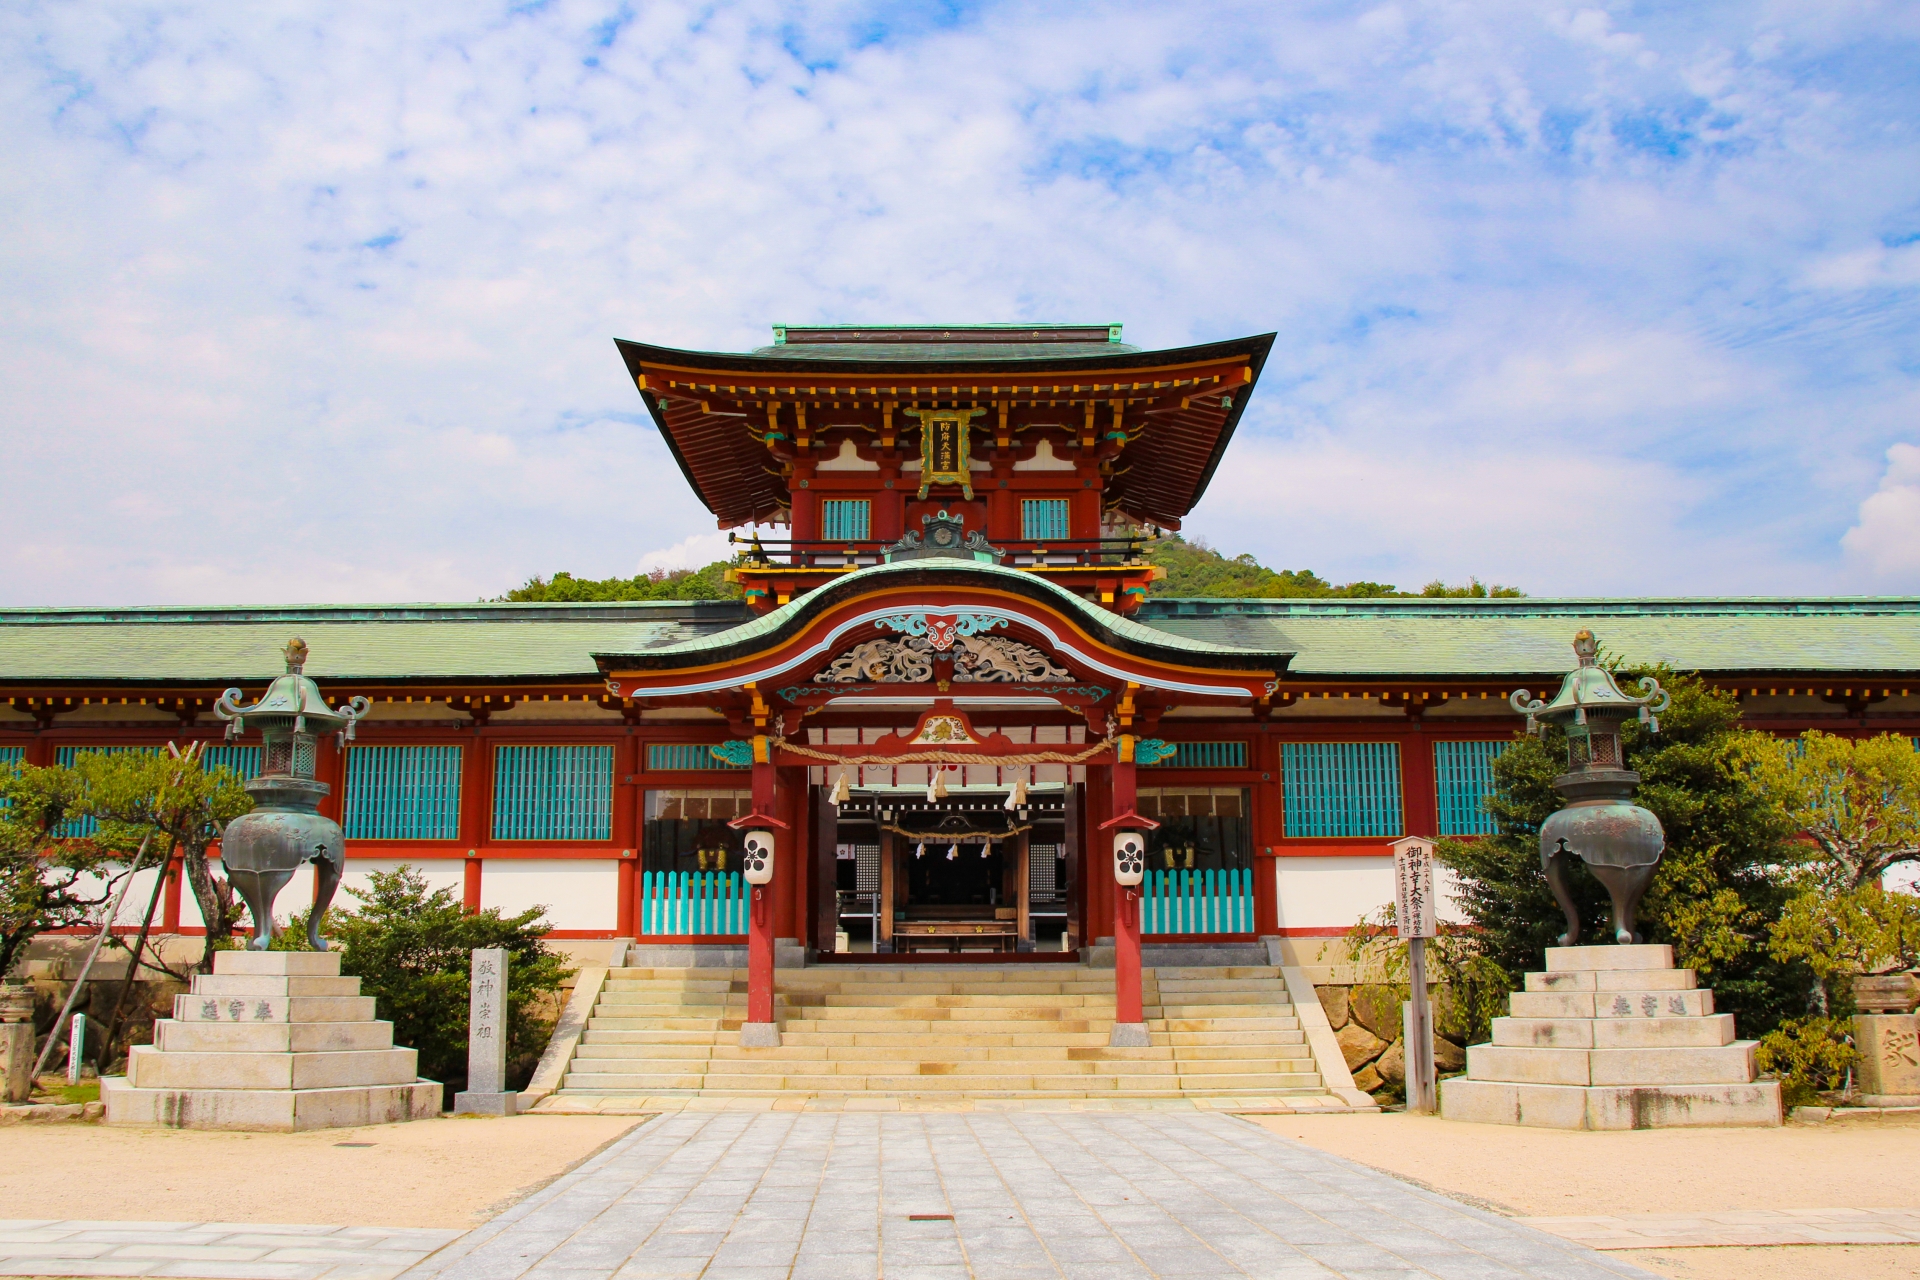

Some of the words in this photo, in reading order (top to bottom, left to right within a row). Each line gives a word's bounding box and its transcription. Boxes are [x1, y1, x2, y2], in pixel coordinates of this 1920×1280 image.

[1423, 853, 1431, 894] 平成二十八年
[476, 960, 496, 1039] 敬神崇祖
